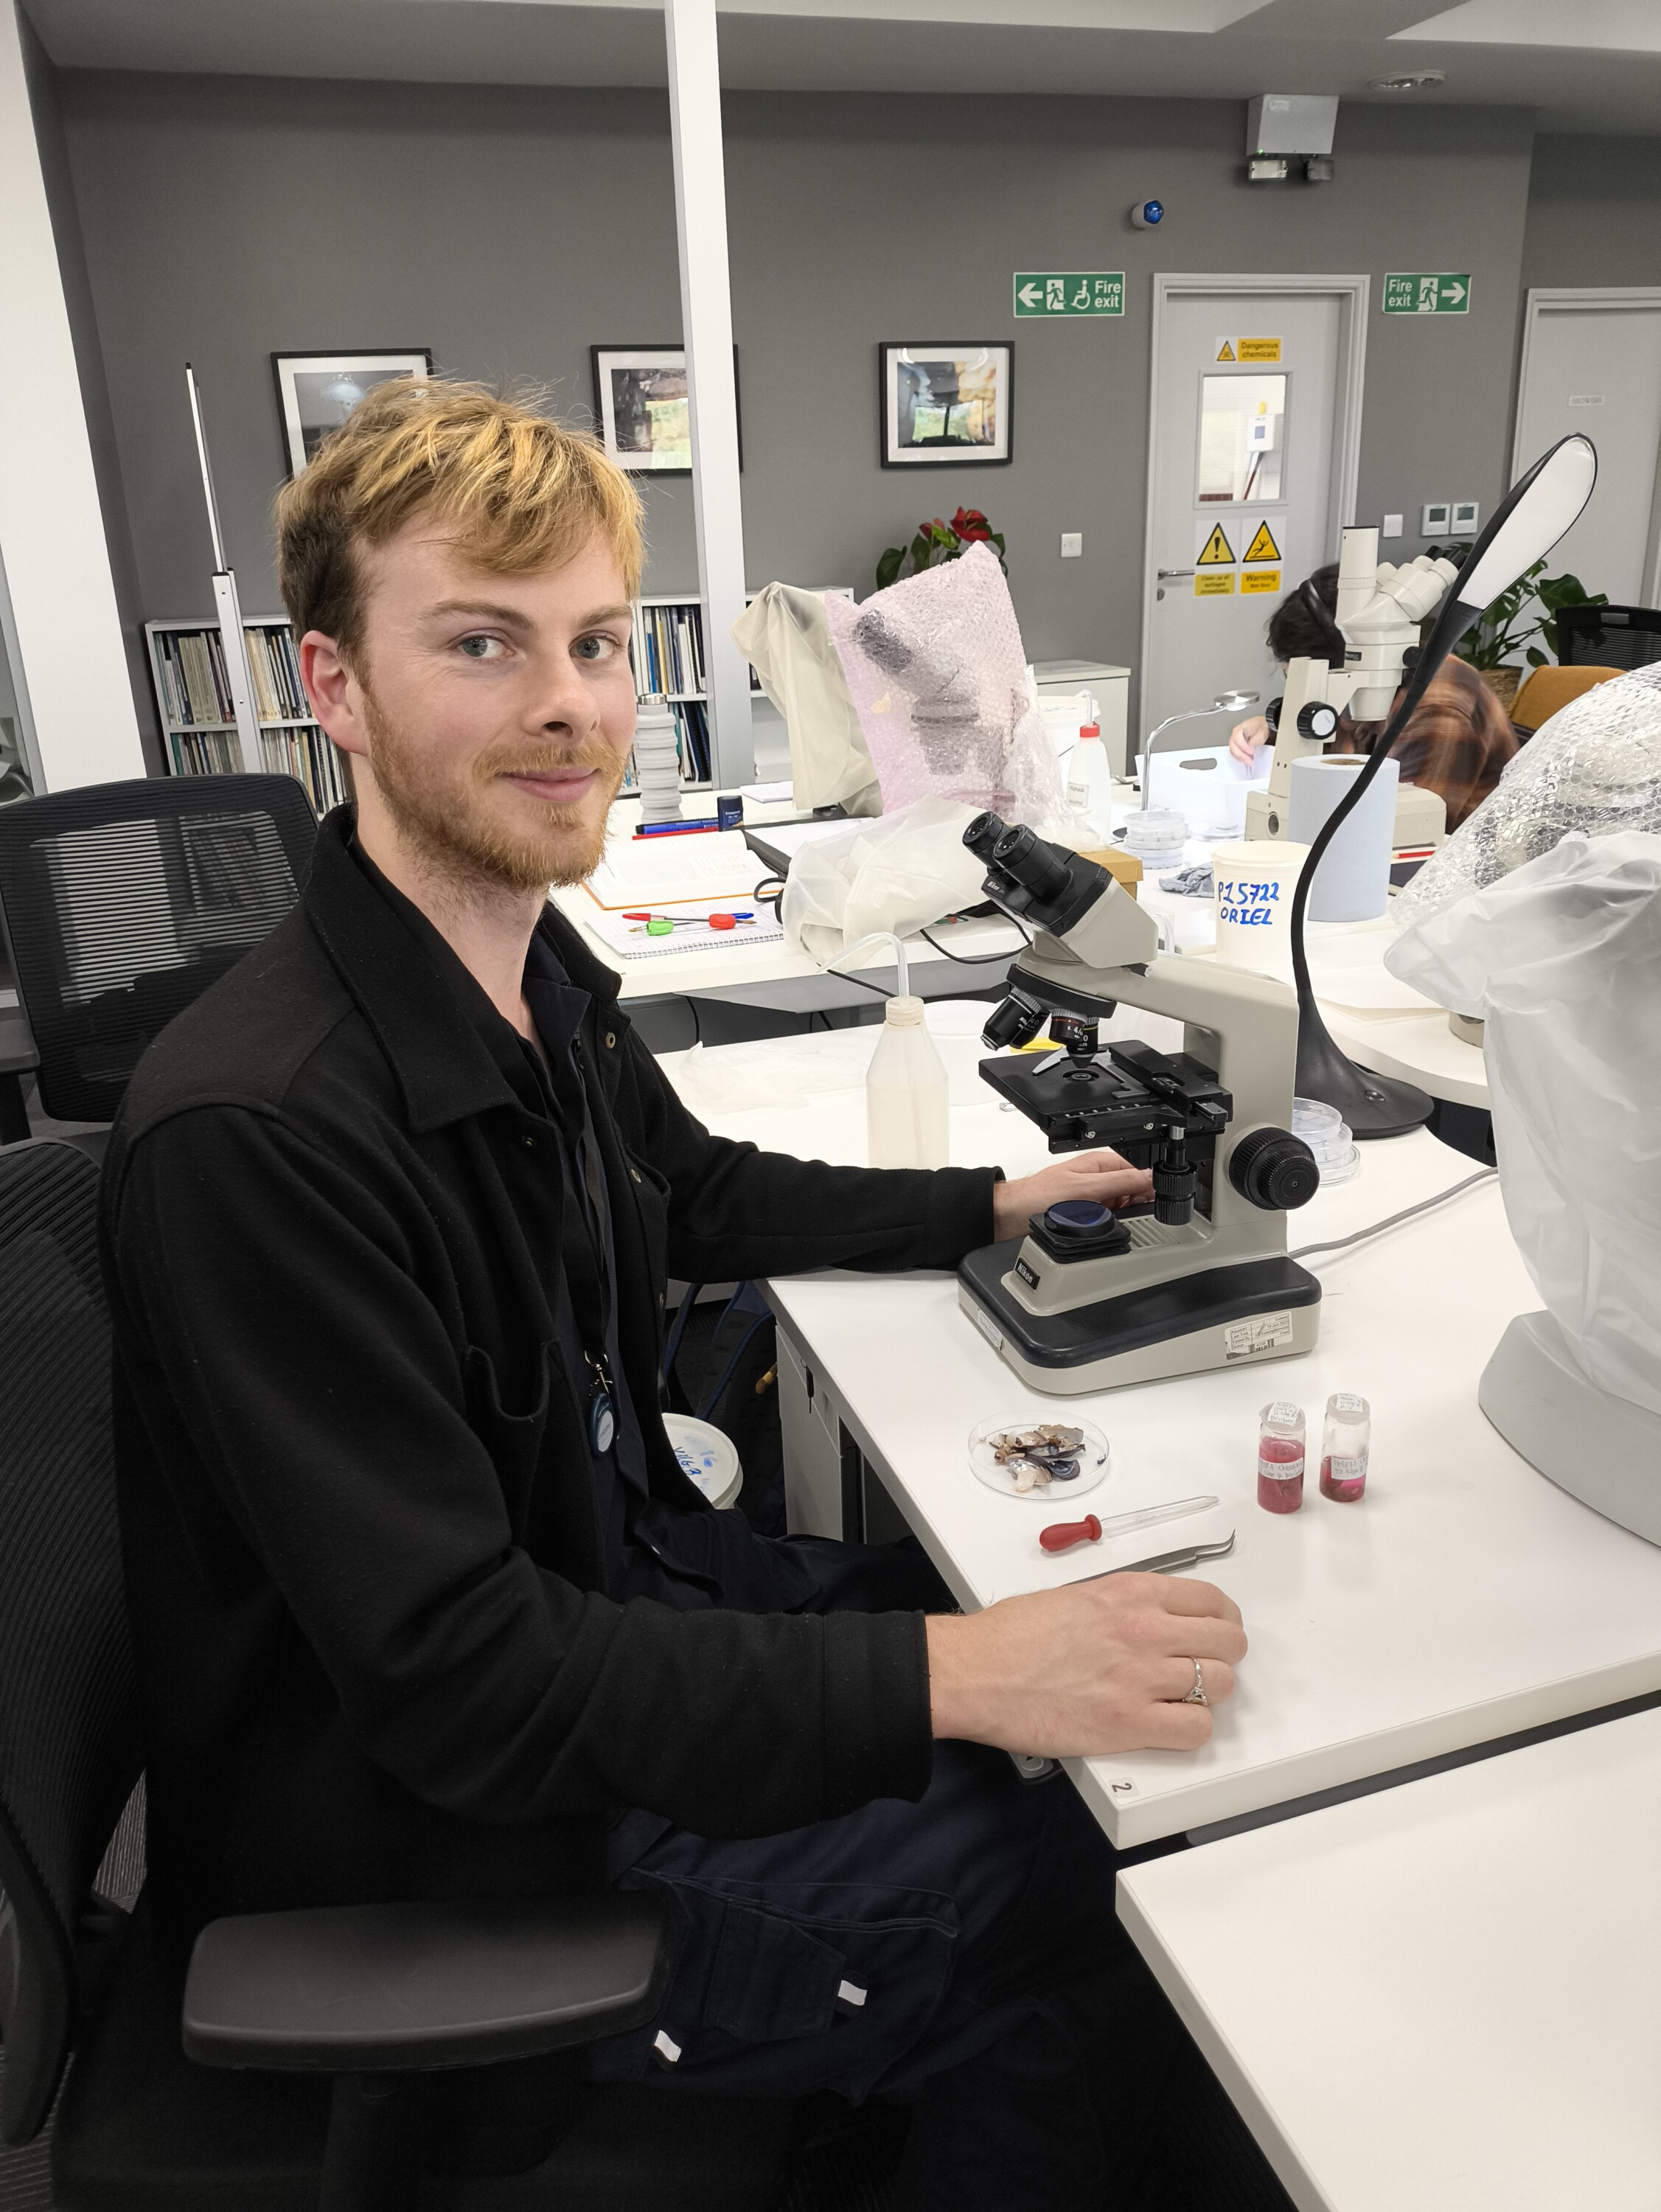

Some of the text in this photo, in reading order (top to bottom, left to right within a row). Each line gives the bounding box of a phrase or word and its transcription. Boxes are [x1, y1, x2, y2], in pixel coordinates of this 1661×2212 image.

[1095, 280, 1121, 294] Fire
[1388, 279, 1413, 293] Fire
[1095, 295, 1120, 308] exit
[1388, 294, 1412, 307] exit
[1241, 342, 1279, 350] Dangerous
[1246, 573, 1277, 582] Warning
[1221, 907, 1272, 925] ORIEL
[1017, 1262, 1034, 1284] Nikon
[1111, 1782, 1132, 1792] 2
